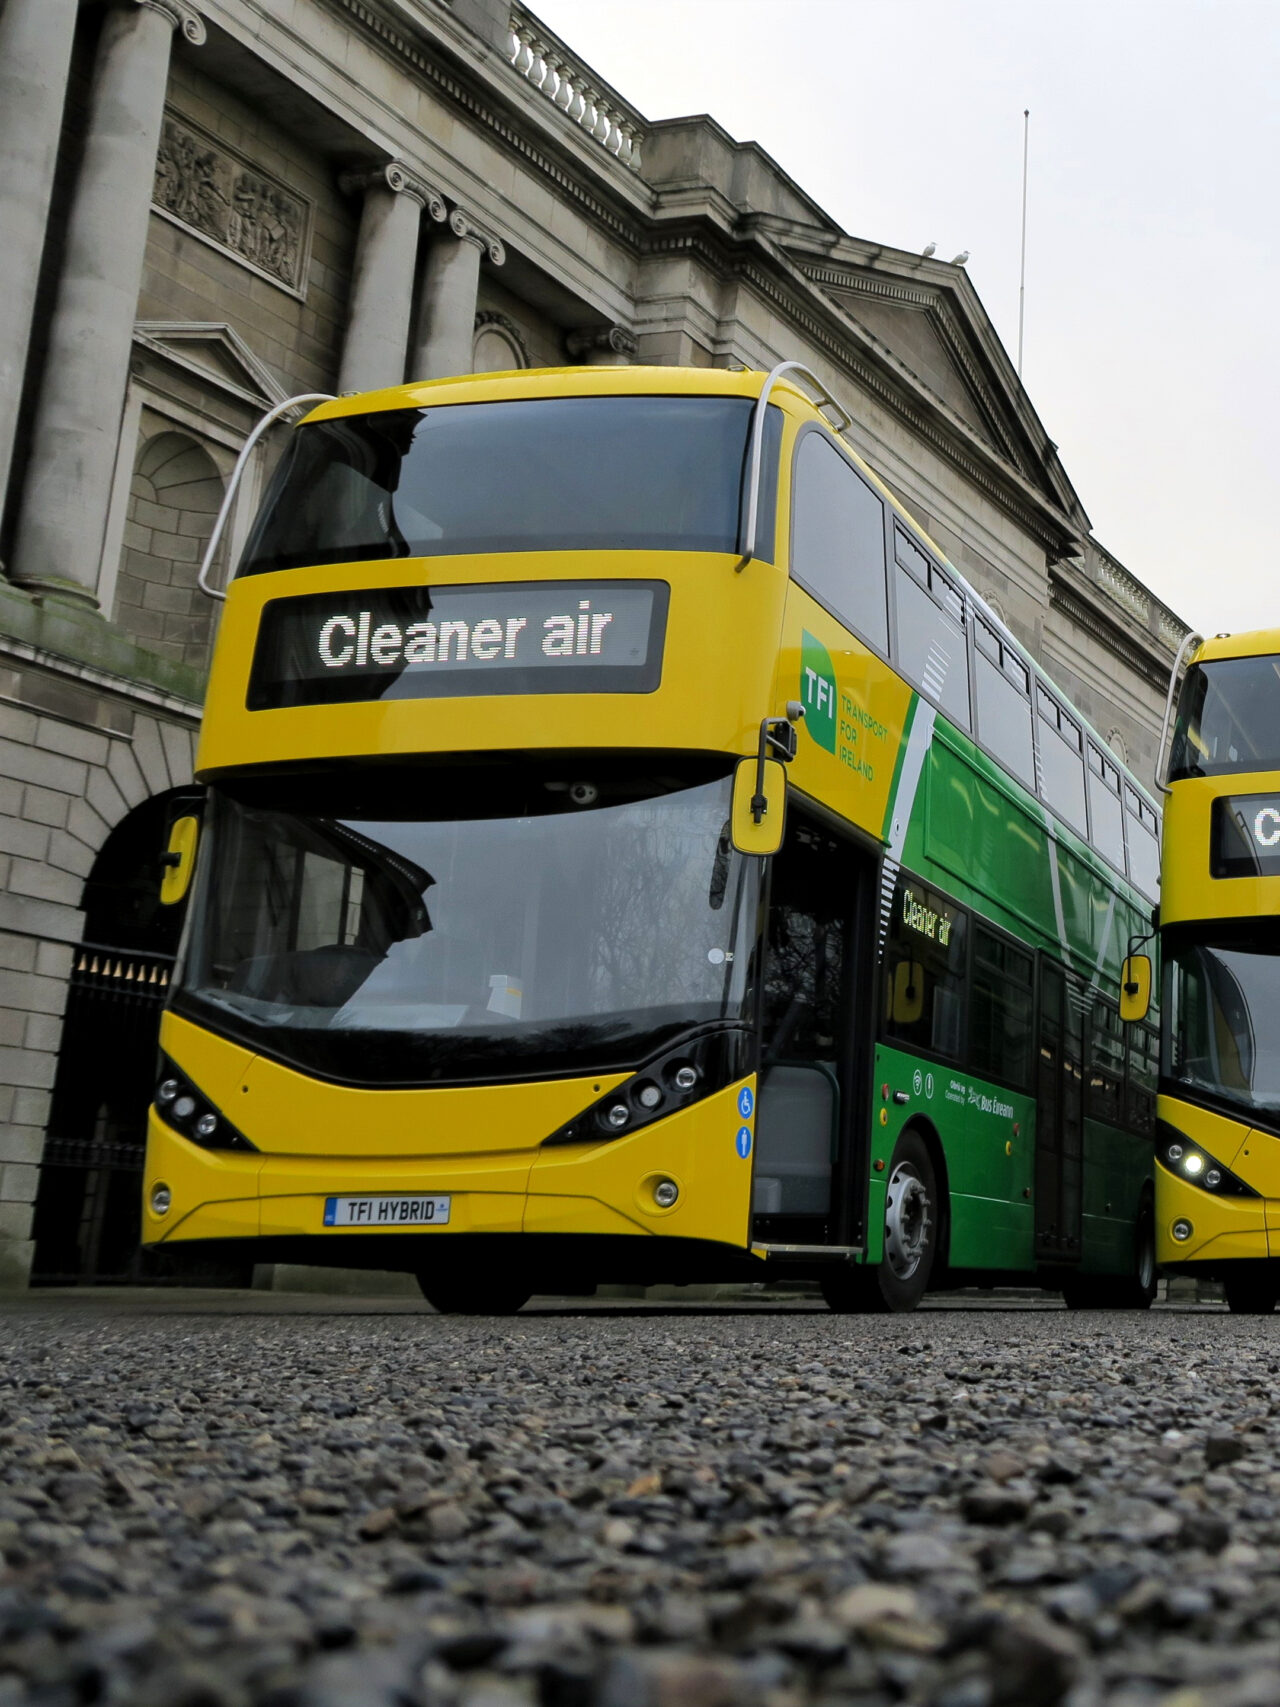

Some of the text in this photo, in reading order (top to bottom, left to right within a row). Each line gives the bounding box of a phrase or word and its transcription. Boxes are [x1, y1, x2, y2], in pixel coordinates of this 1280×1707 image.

[318, 600, 613, 667] Cleaner air
[805, 666, 834, 719] TFI
[840, 720, 857, 746] FOR
[841, 695, 888, 743] TRANSPORT
[839, 745, 874, 781] IRELAND
[903, 889, 951, 946] Cleaner air
[981, 1095, 992, 1112] Bus
[348, 1200, 435, 1221] TFI HYBRID
